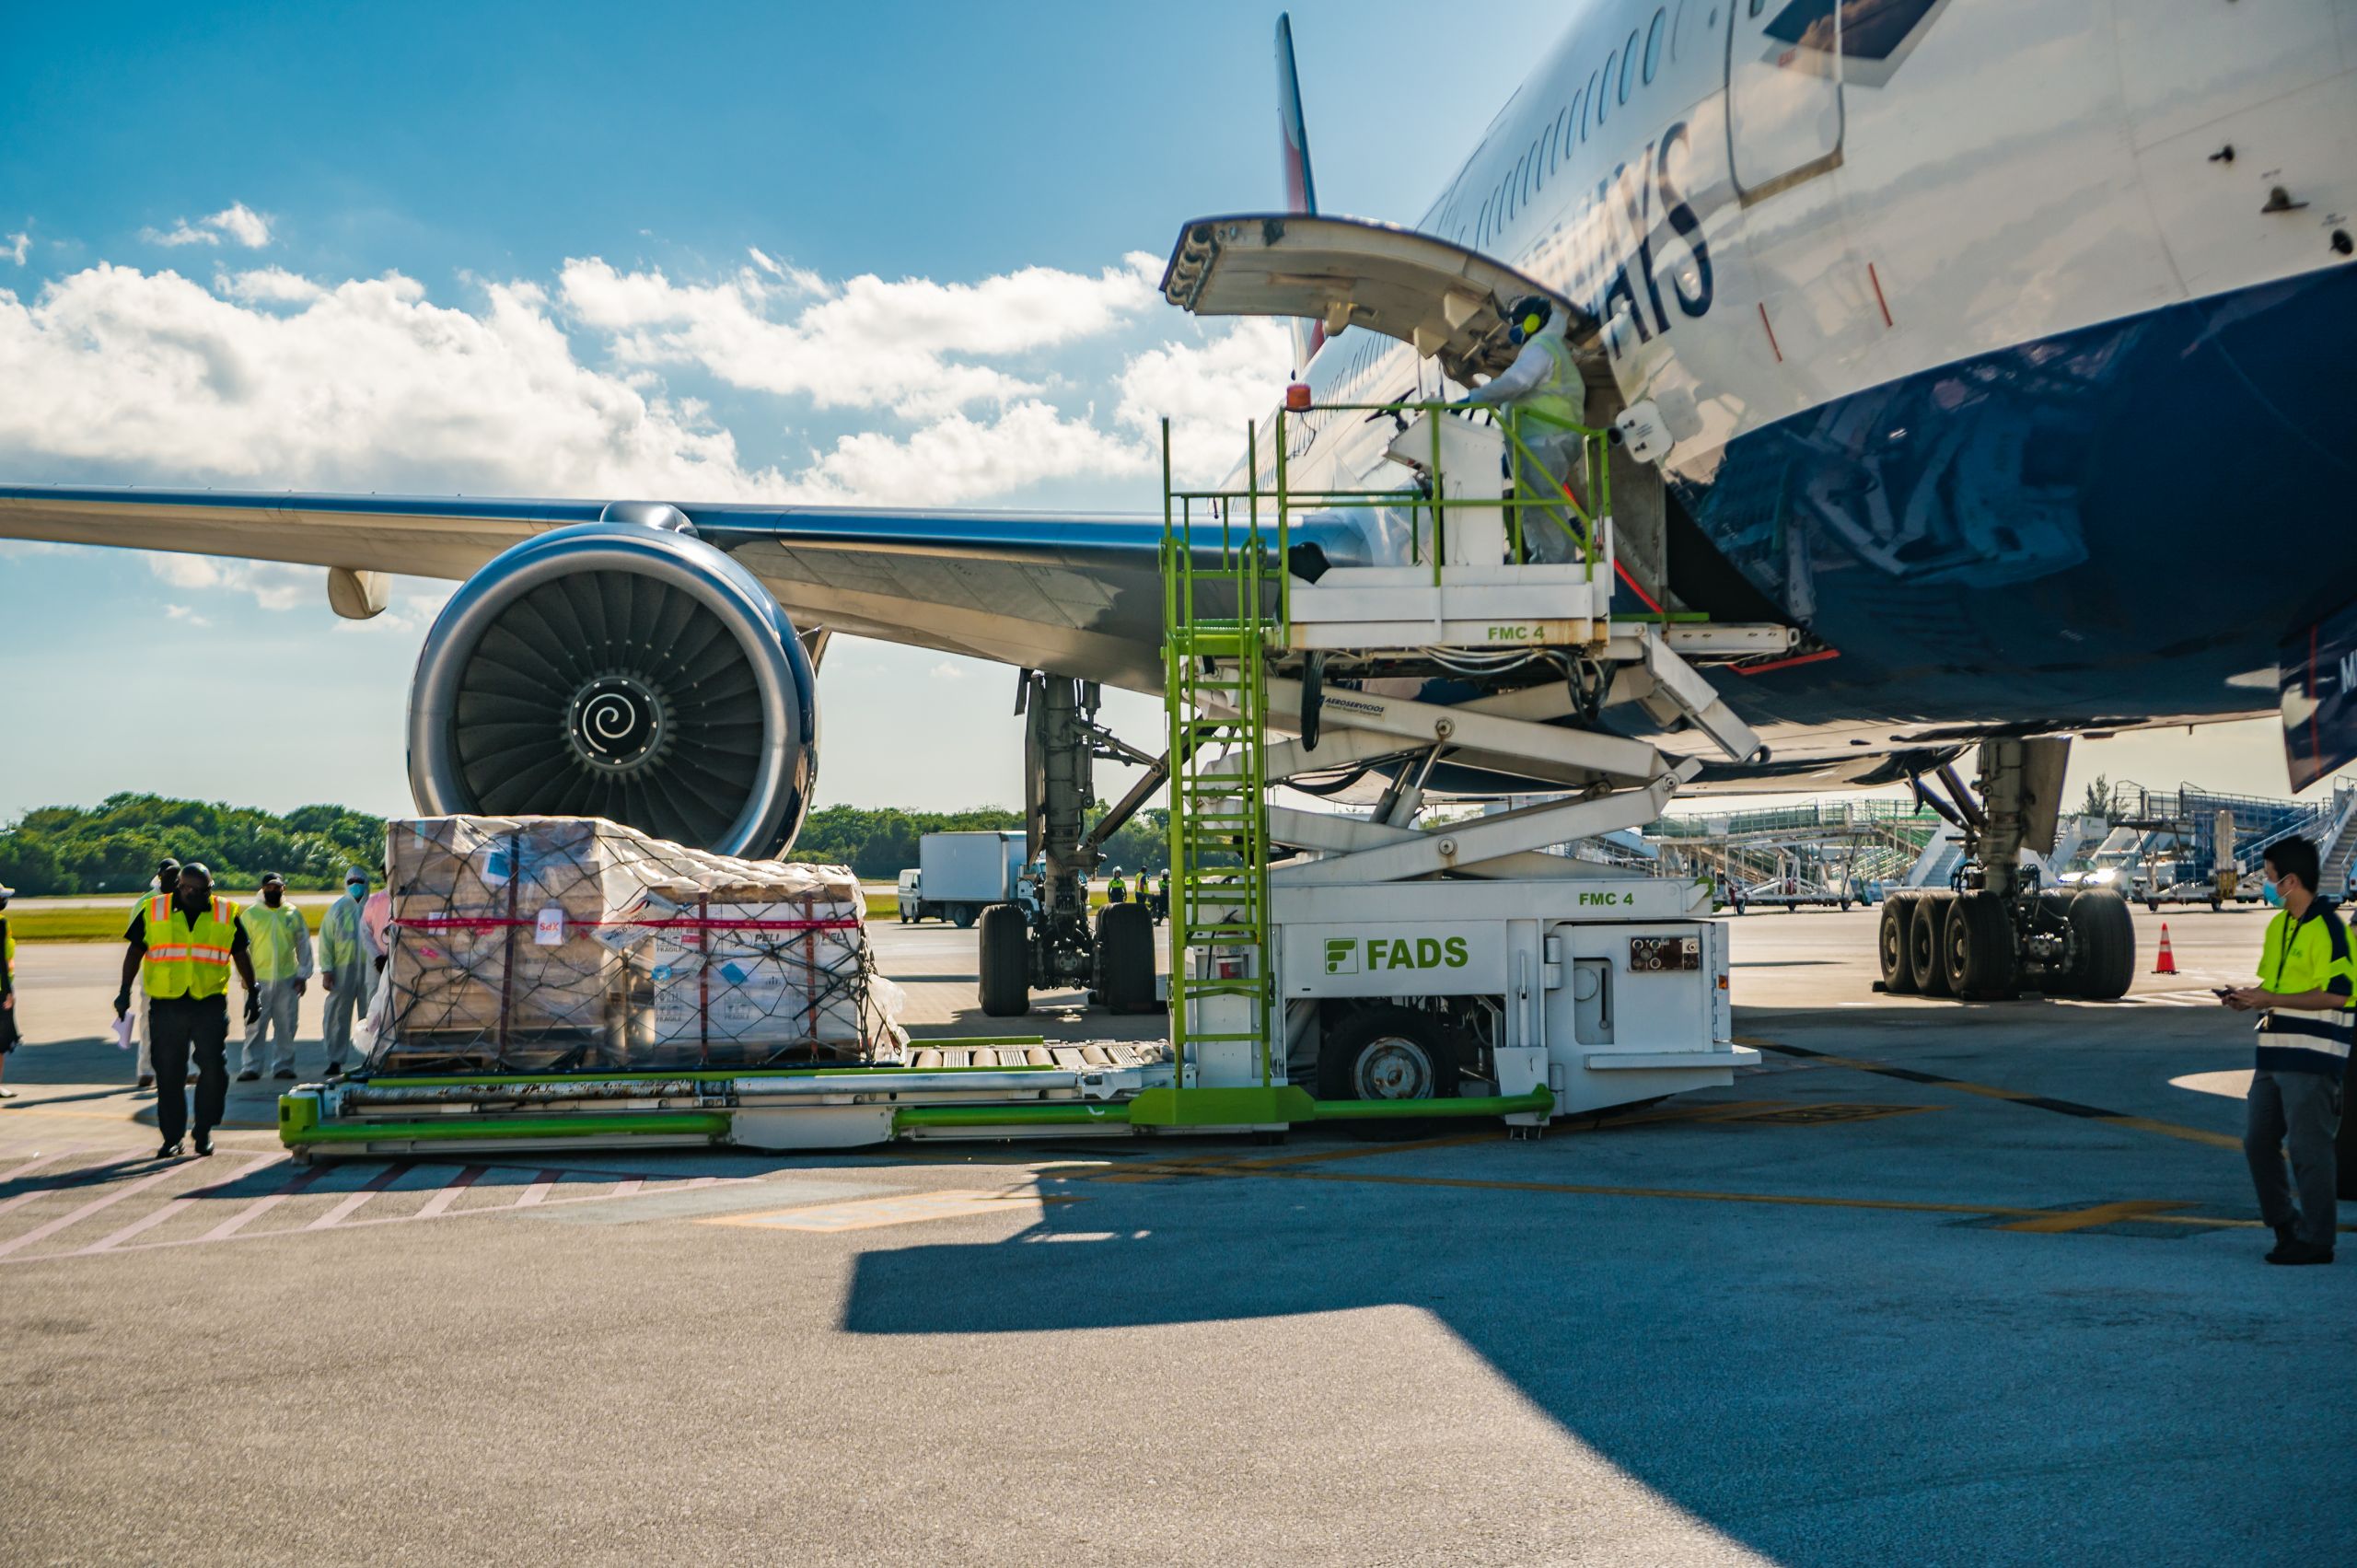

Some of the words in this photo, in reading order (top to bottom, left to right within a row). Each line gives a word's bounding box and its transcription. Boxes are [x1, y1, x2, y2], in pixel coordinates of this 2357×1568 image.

[1488, 626, 1527, 640] FMC
[1533, 626, 1545, 639] 4
[1325, 697, 1385, 713] AEROSERVICIOS
[1579, 892, 1617, 906] FMC
[1623, 892, 1634, 906] 4
[754, 933, 780, 943] PELI
[1367, 936, 1469, 970] FADS
